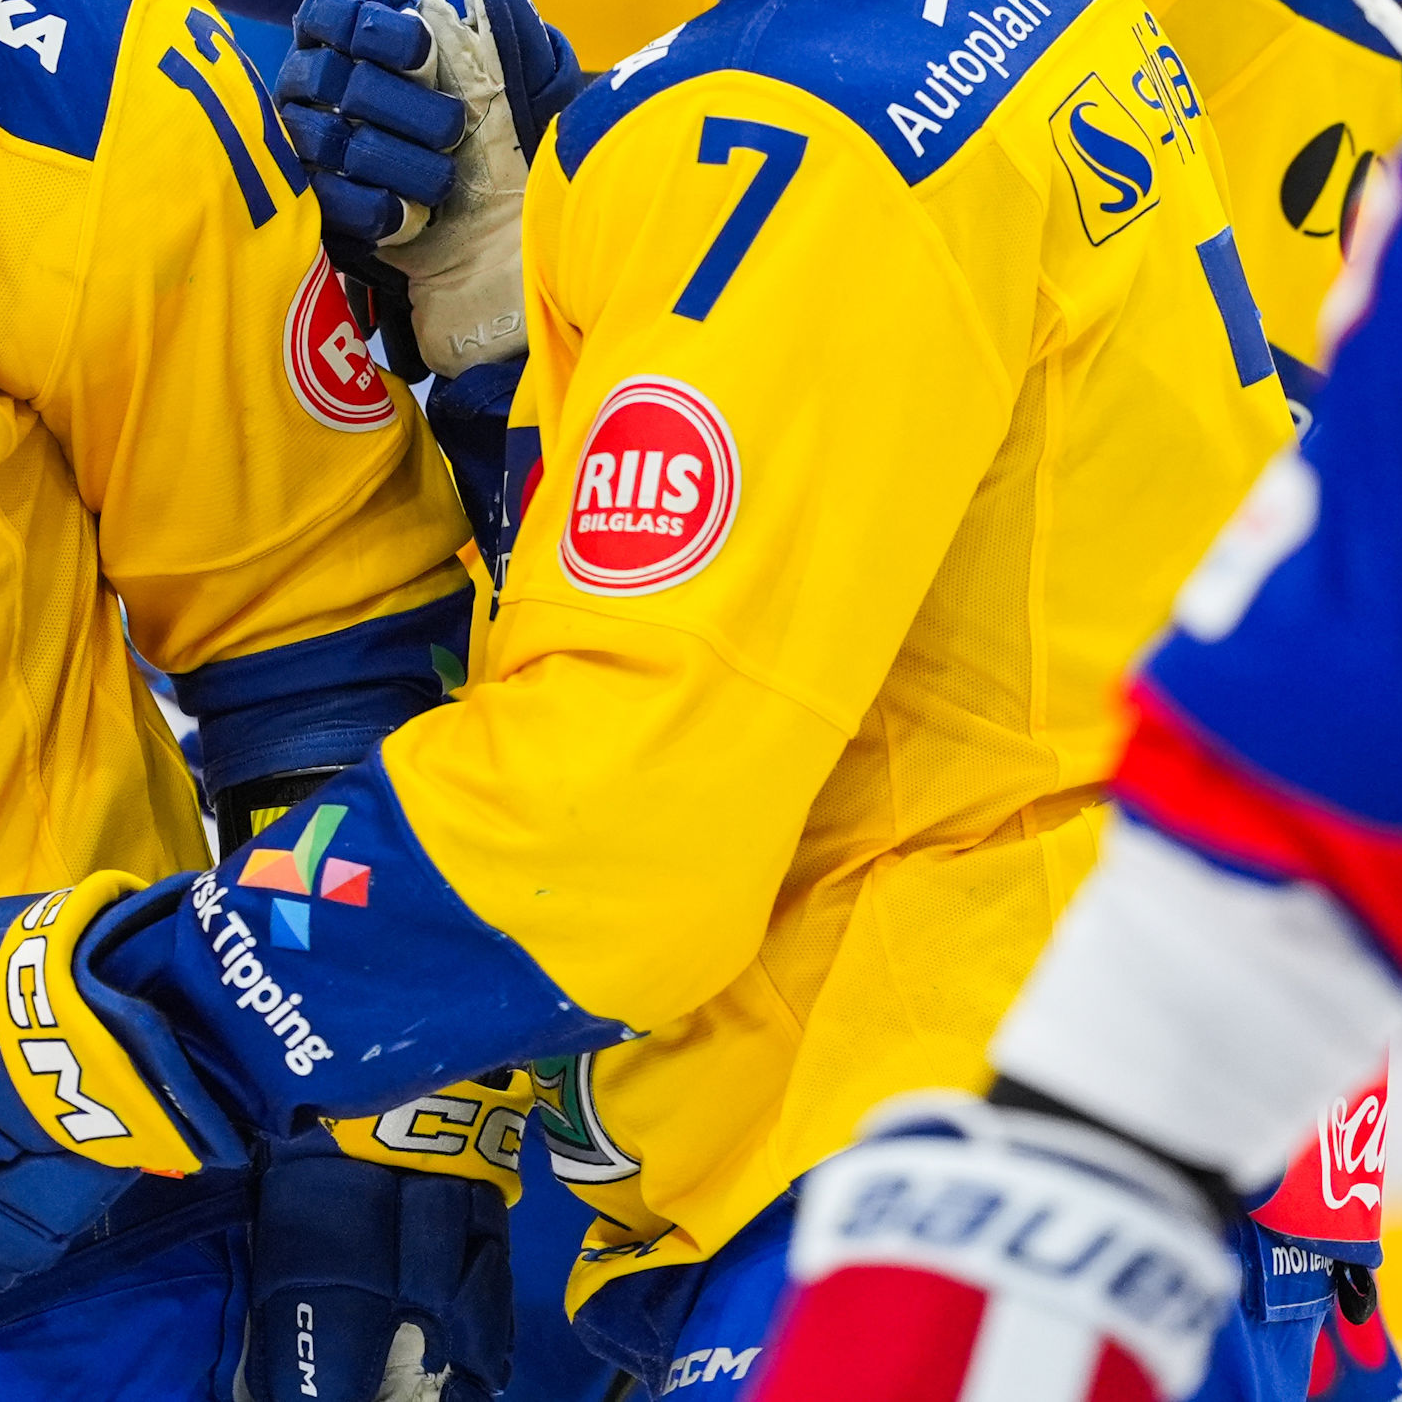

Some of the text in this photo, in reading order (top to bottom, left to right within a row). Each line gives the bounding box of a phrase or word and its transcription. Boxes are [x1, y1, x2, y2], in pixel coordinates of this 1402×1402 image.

[673, 115, 809, 323] 7
[576, 450, 703, 512] RIIS
[577, 512, 684, 537] BILGLASS
[5, 887, 130, 1144] CCM
[212, 910, 335, 1076] Tipping
[373, 1094, 527, 1173] CC
[296, 1301, 319, 1397] CCM
[661, 1347, 765, 1397] CCM
